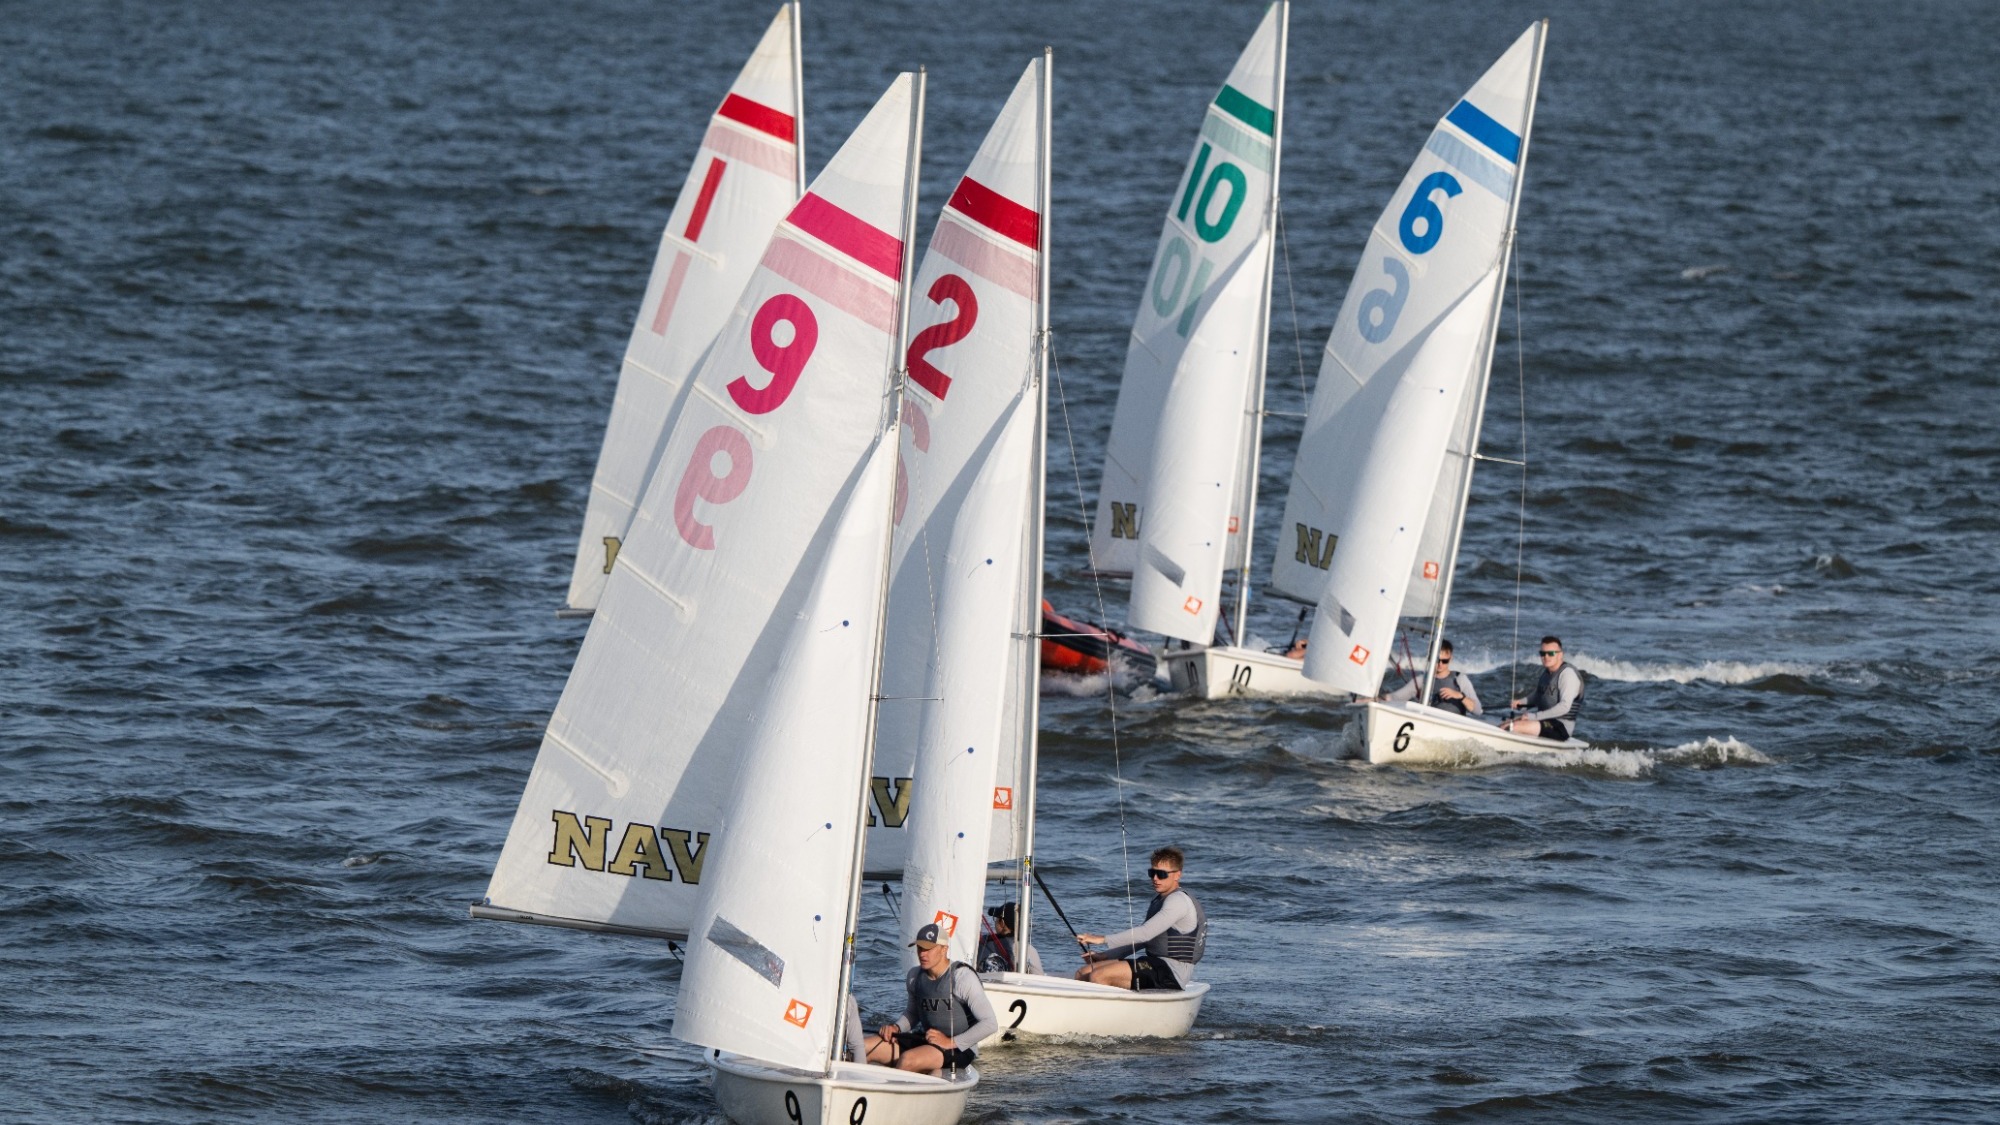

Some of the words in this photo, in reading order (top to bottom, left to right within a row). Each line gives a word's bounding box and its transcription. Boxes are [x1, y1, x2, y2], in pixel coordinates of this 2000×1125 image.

[684, 157, 728, 244] 1
[1177, 141, 1248, 244] 10
[1398, 171, 1463, 255] 6
[726, 293, 819, 415] 9
[906, 273, 979, 401] 2
[1227, 663, 1252, 696] 10
[1393, 721, 1415, 753] 6
[1001, 998, 1027, 1042] 2
[785, 1089, 803, 1125] 9
